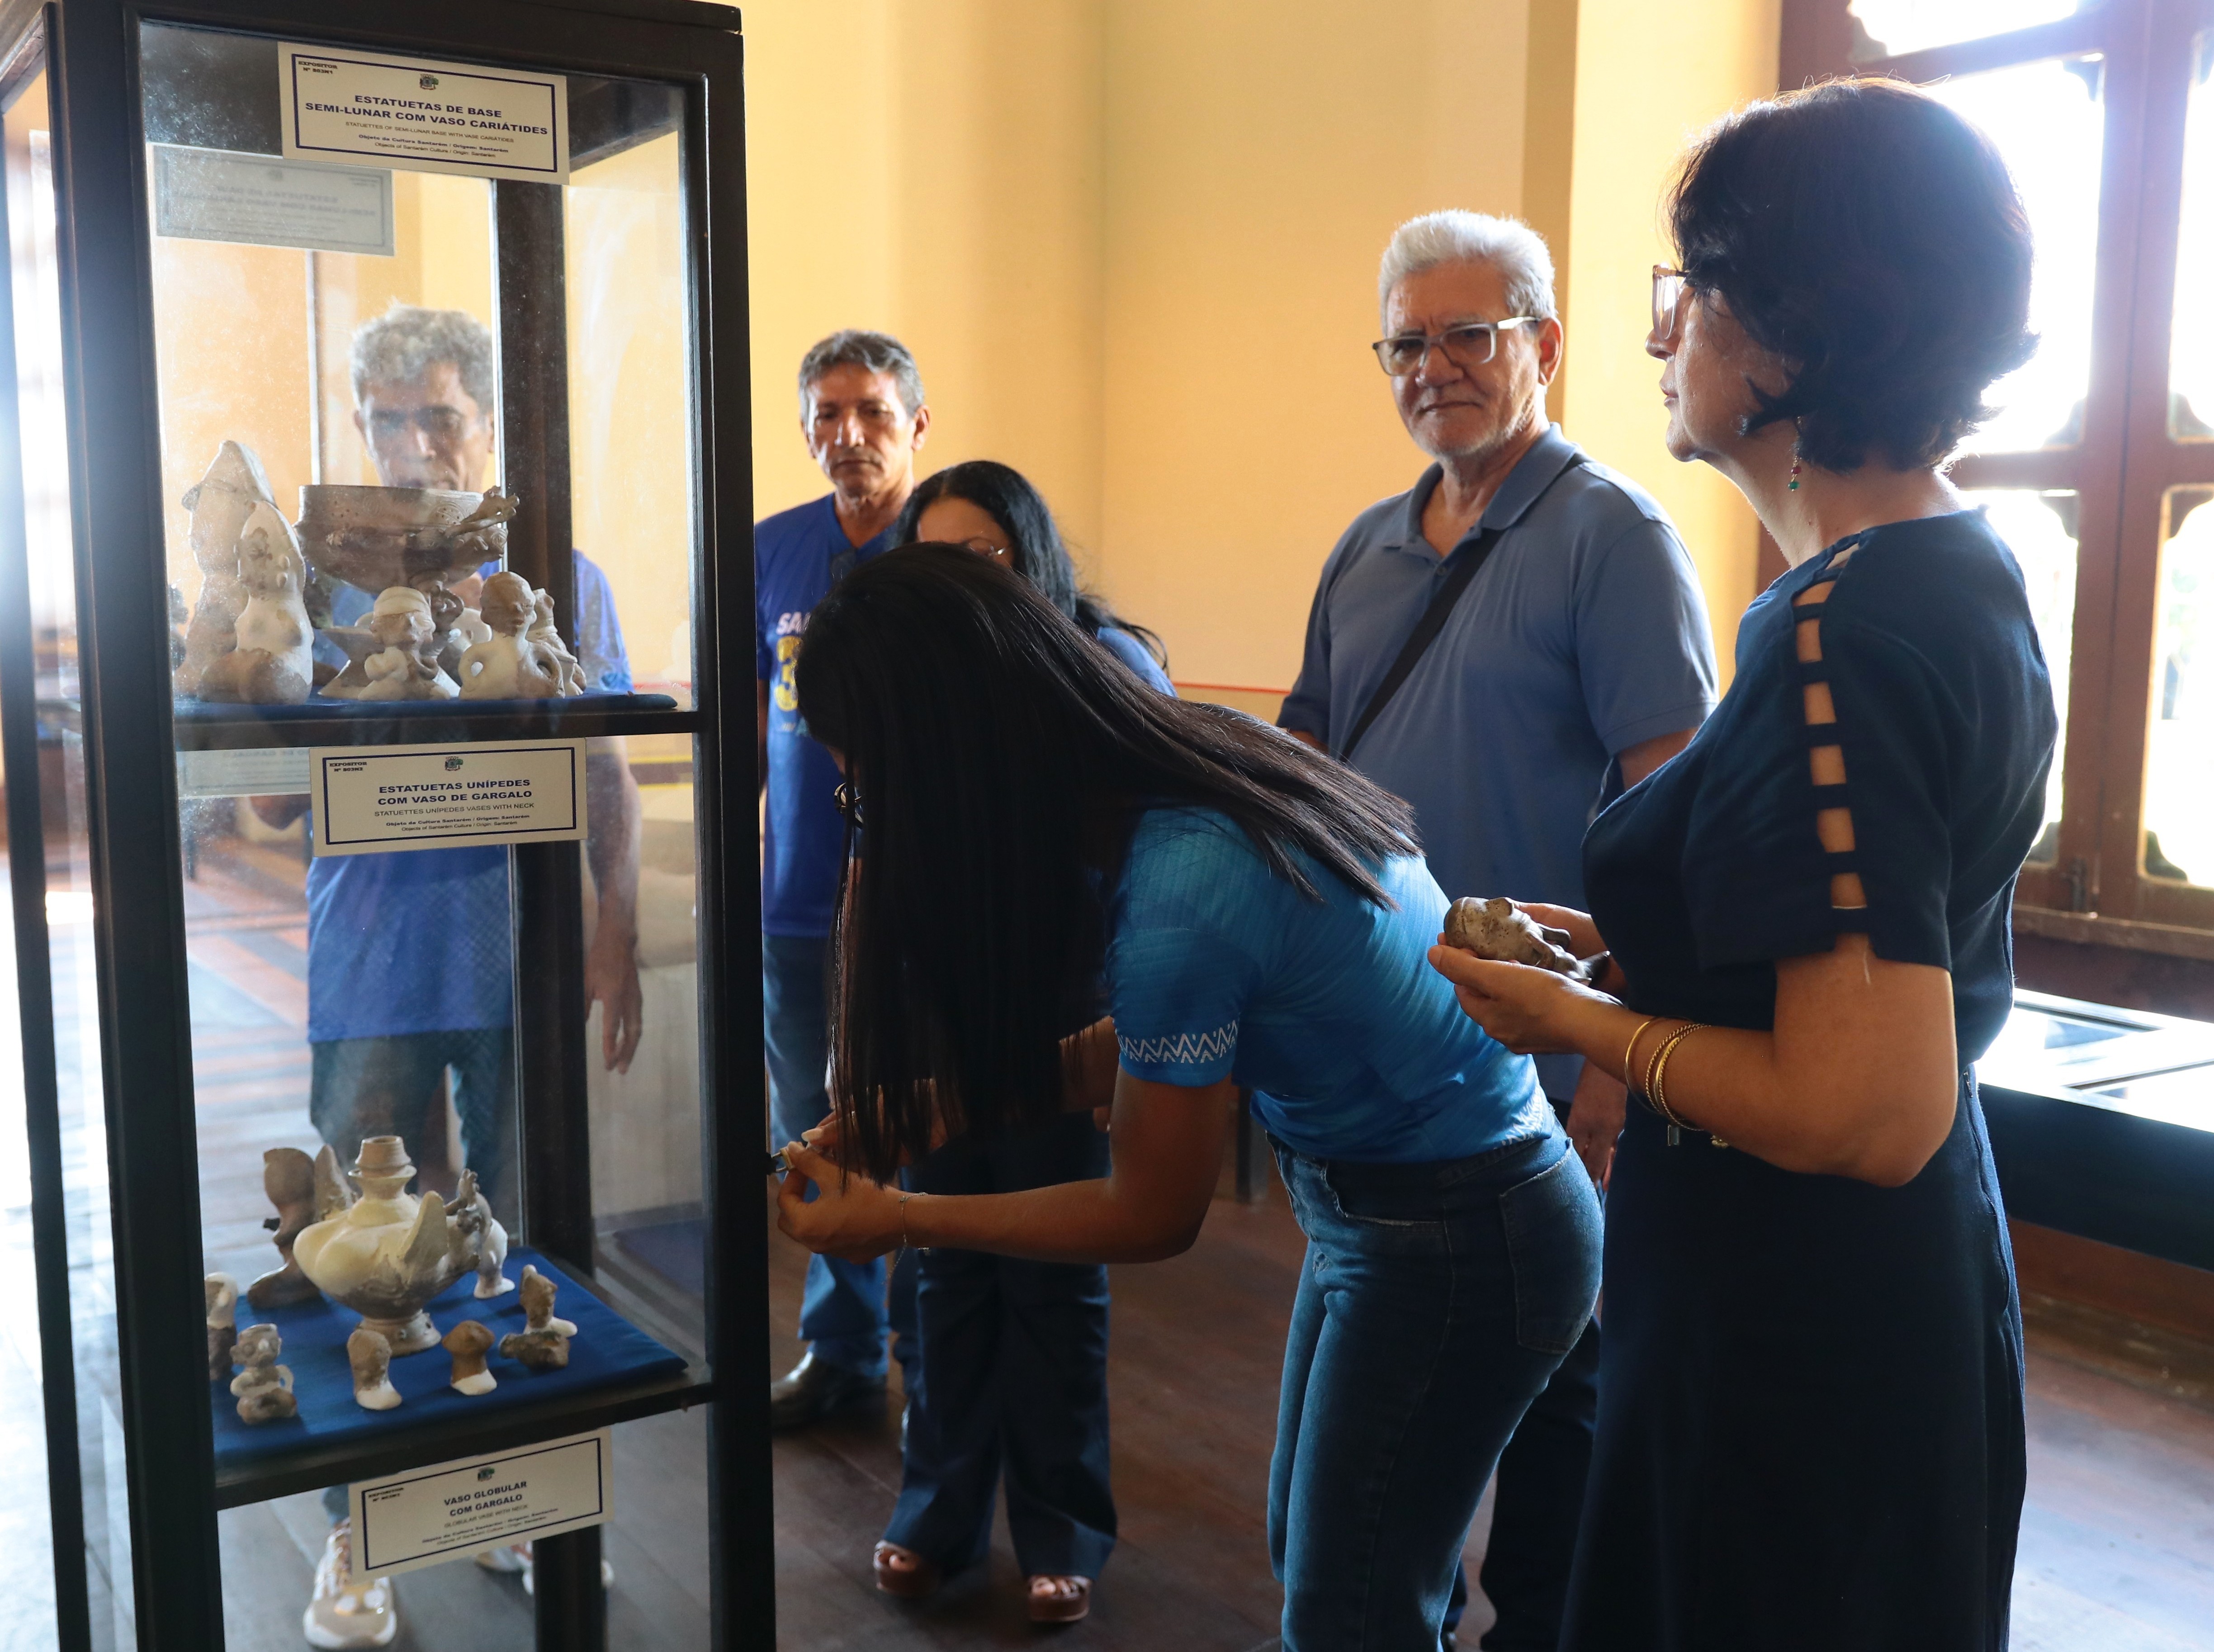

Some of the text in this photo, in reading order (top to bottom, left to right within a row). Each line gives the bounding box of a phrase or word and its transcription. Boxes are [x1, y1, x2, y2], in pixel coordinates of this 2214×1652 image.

[355, 95, 441, 110] ESTATUETAS
[468, 108, 501, 117] BASE
[306, 103, 547, 134] SEMI-LUNAR COM VASO CARIÁTIDES
[379, 780, 530, 793] ESTATUETAS UNÍPEDES
[472, 791, 531, 800] GARGALO
[444, 1481, 526, 1505] VASO GLOBULAR
[450, 1494, 522, 1516] COM GARGALO
